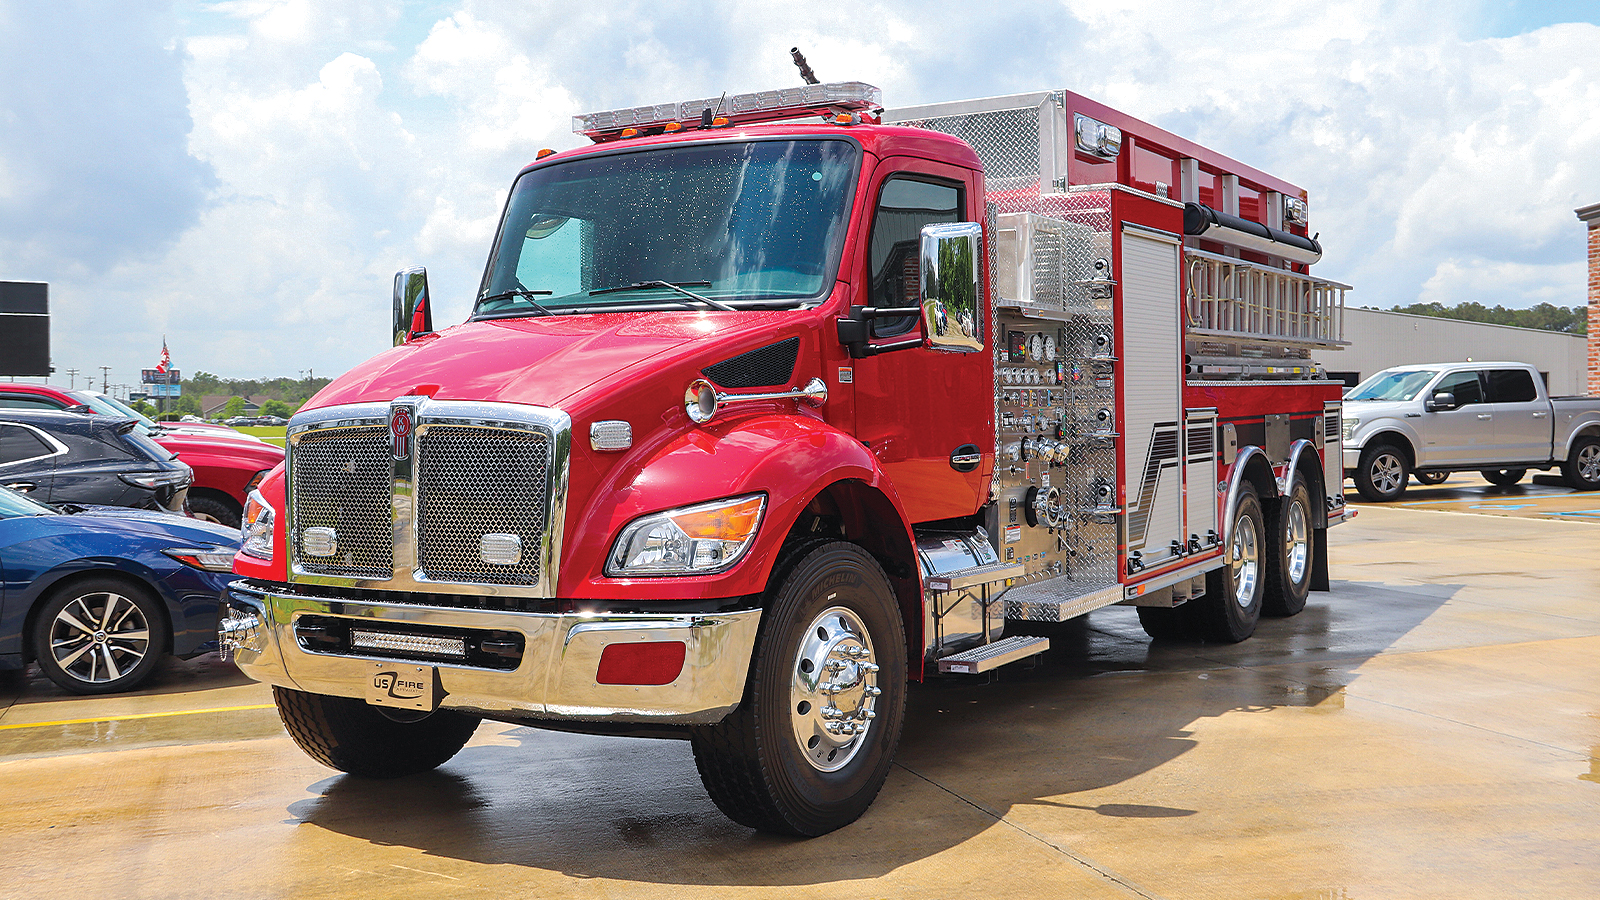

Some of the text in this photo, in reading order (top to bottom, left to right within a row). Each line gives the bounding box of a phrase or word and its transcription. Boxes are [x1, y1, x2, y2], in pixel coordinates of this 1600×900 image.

[812, 572, 857, 600] MICHELIN
[374, 678, 424, 690] US FIRE
